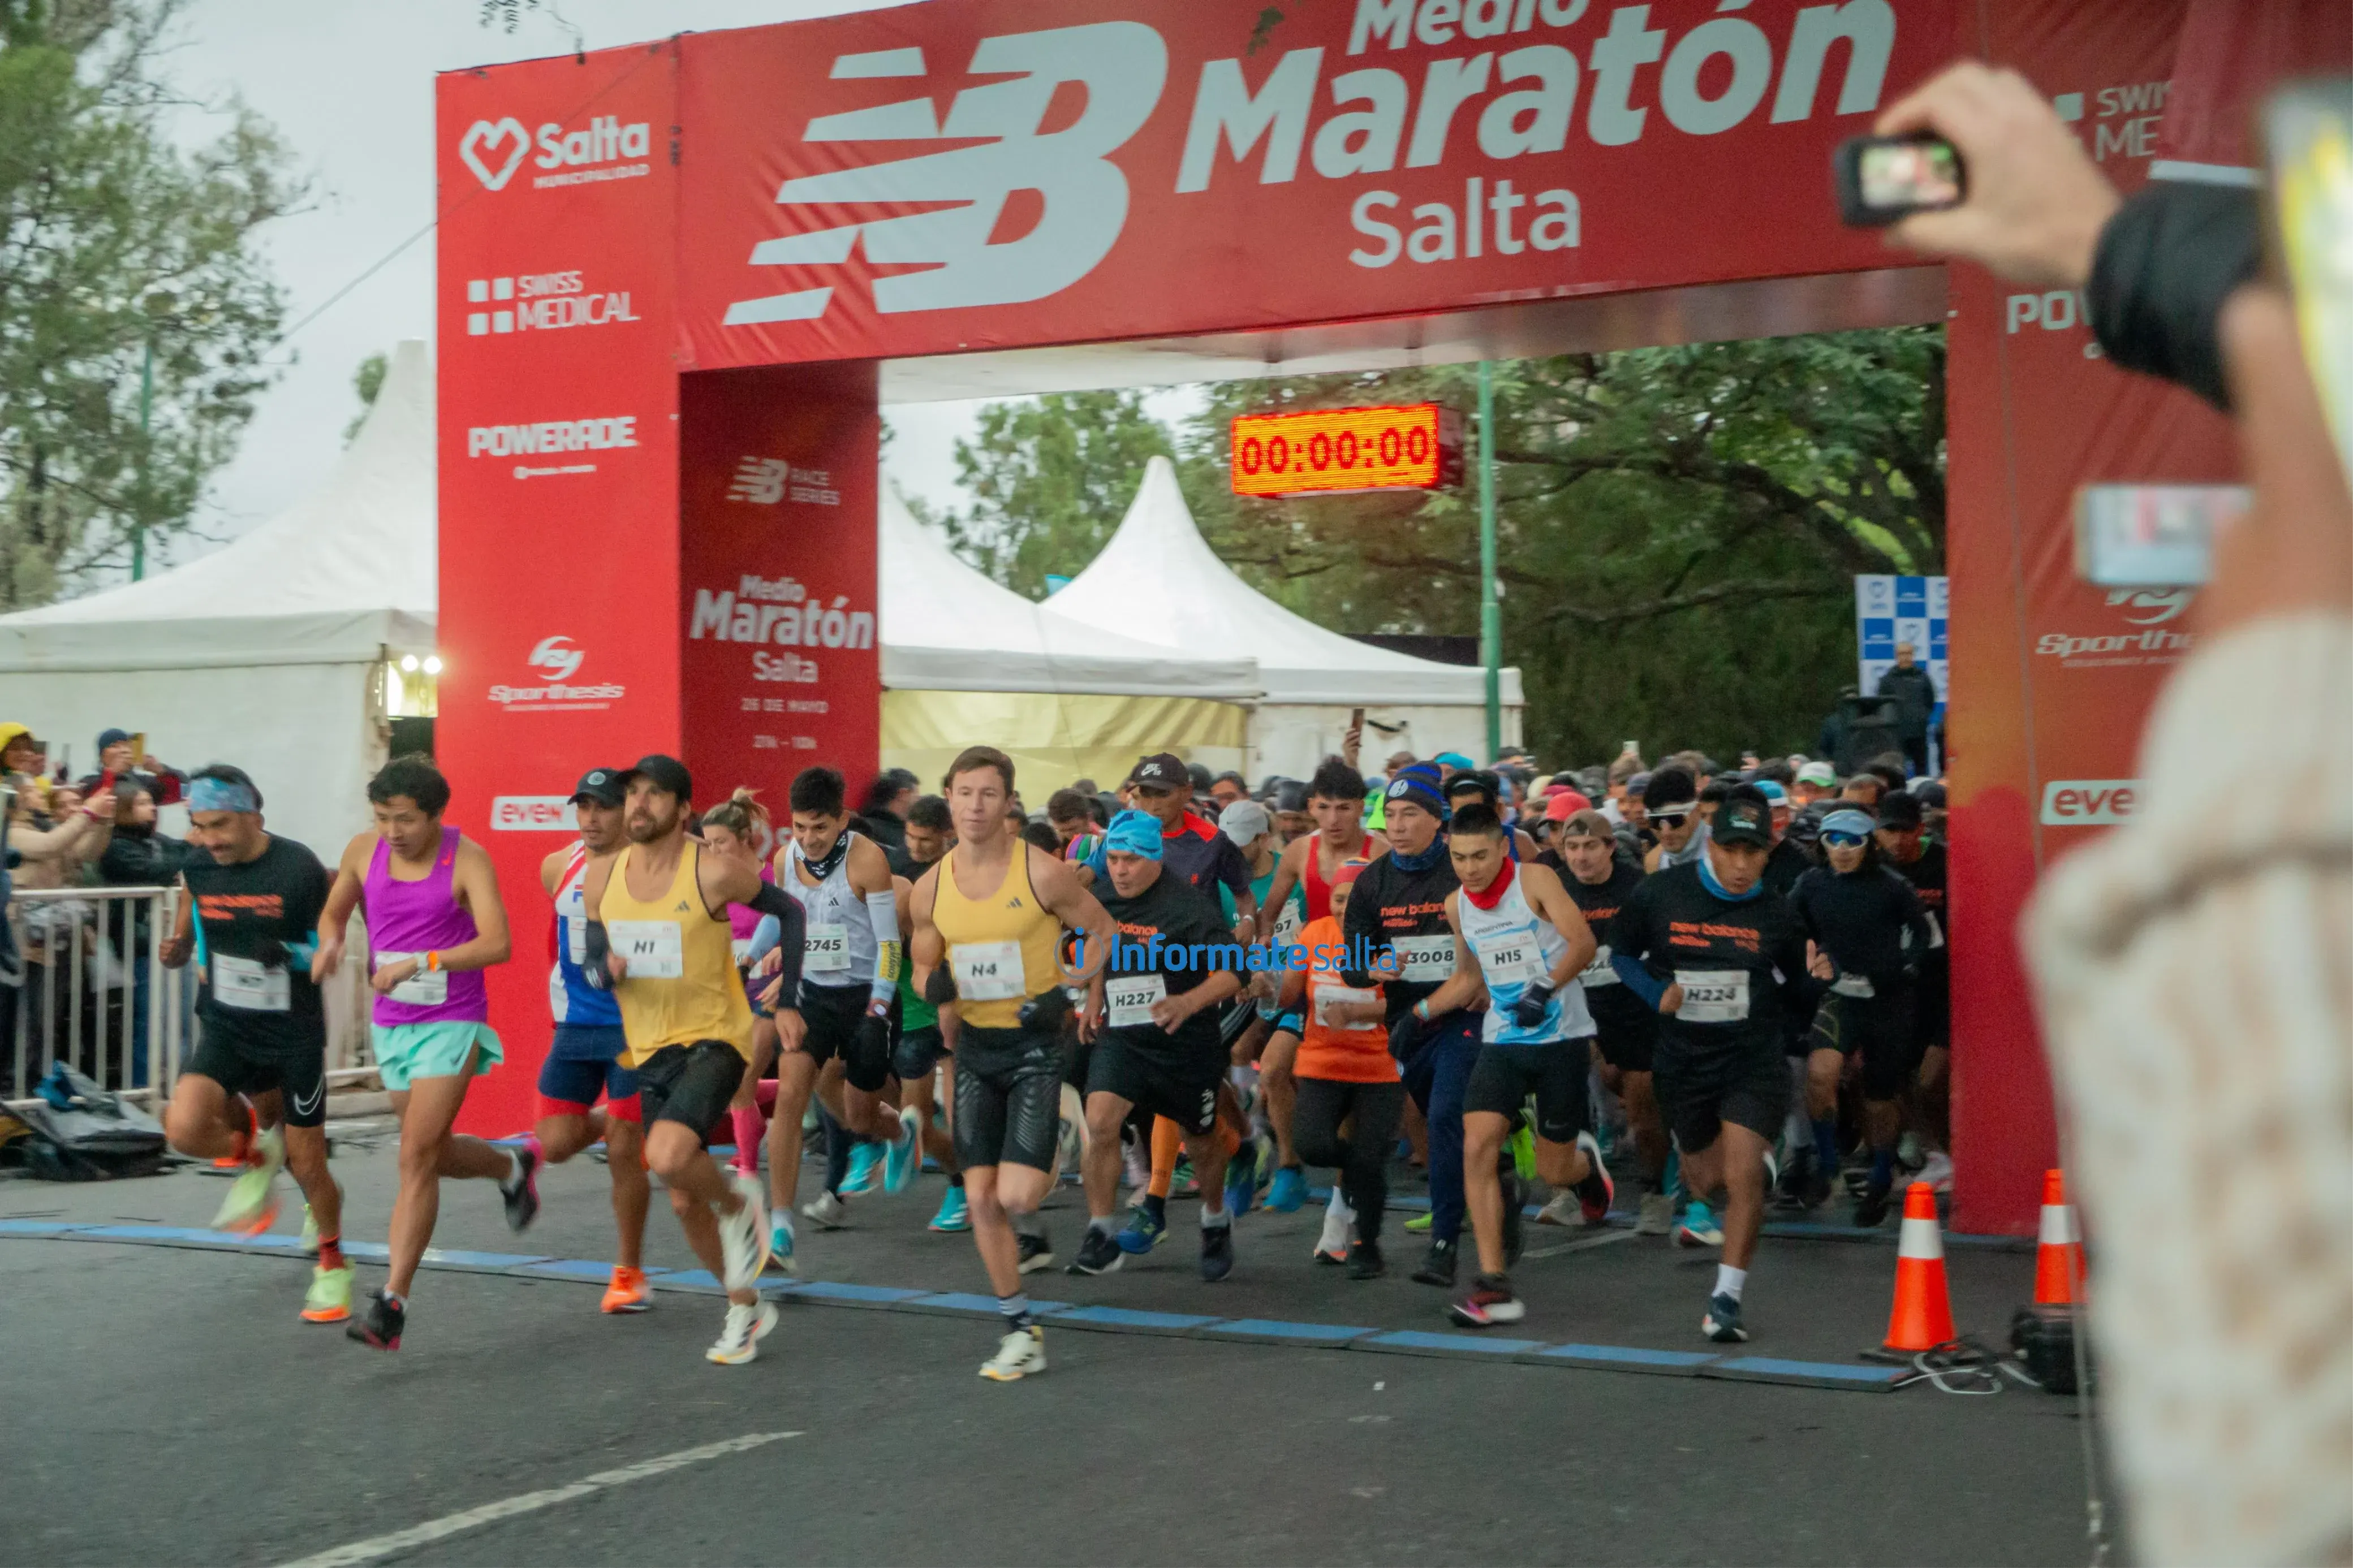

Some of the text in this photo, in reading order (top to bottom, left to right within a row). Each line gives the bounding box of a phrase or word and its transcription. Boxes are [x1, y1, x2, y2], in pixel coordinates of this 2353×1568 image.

[1345, 0, 1590, 56] Medio
[1174, 0, 1899, 193] Maratón
[534, 116, 650, 169] Salta
[1348, 177, 1582, 269] Salta
[518, 271, 584, 297] SWISS
[518, 292, 641, 331] MEDICAL
[468, 416, 639, 457] POWERADE
[1242, 426, 1428, 475] 00:00:00
[689, 589, 874, 649] Maratón
[752, 651, 818, 683] Salta
[804, 939, 842, 952] 2745
[1473, 921, 1514, 935] ARGENTINA
[633, 940, 656, 954] H1
[1408, 950, 1454, 964] 3008
[1494, 949, 1522, 966] H15
[1115, 991, 1156, 1007] H227
